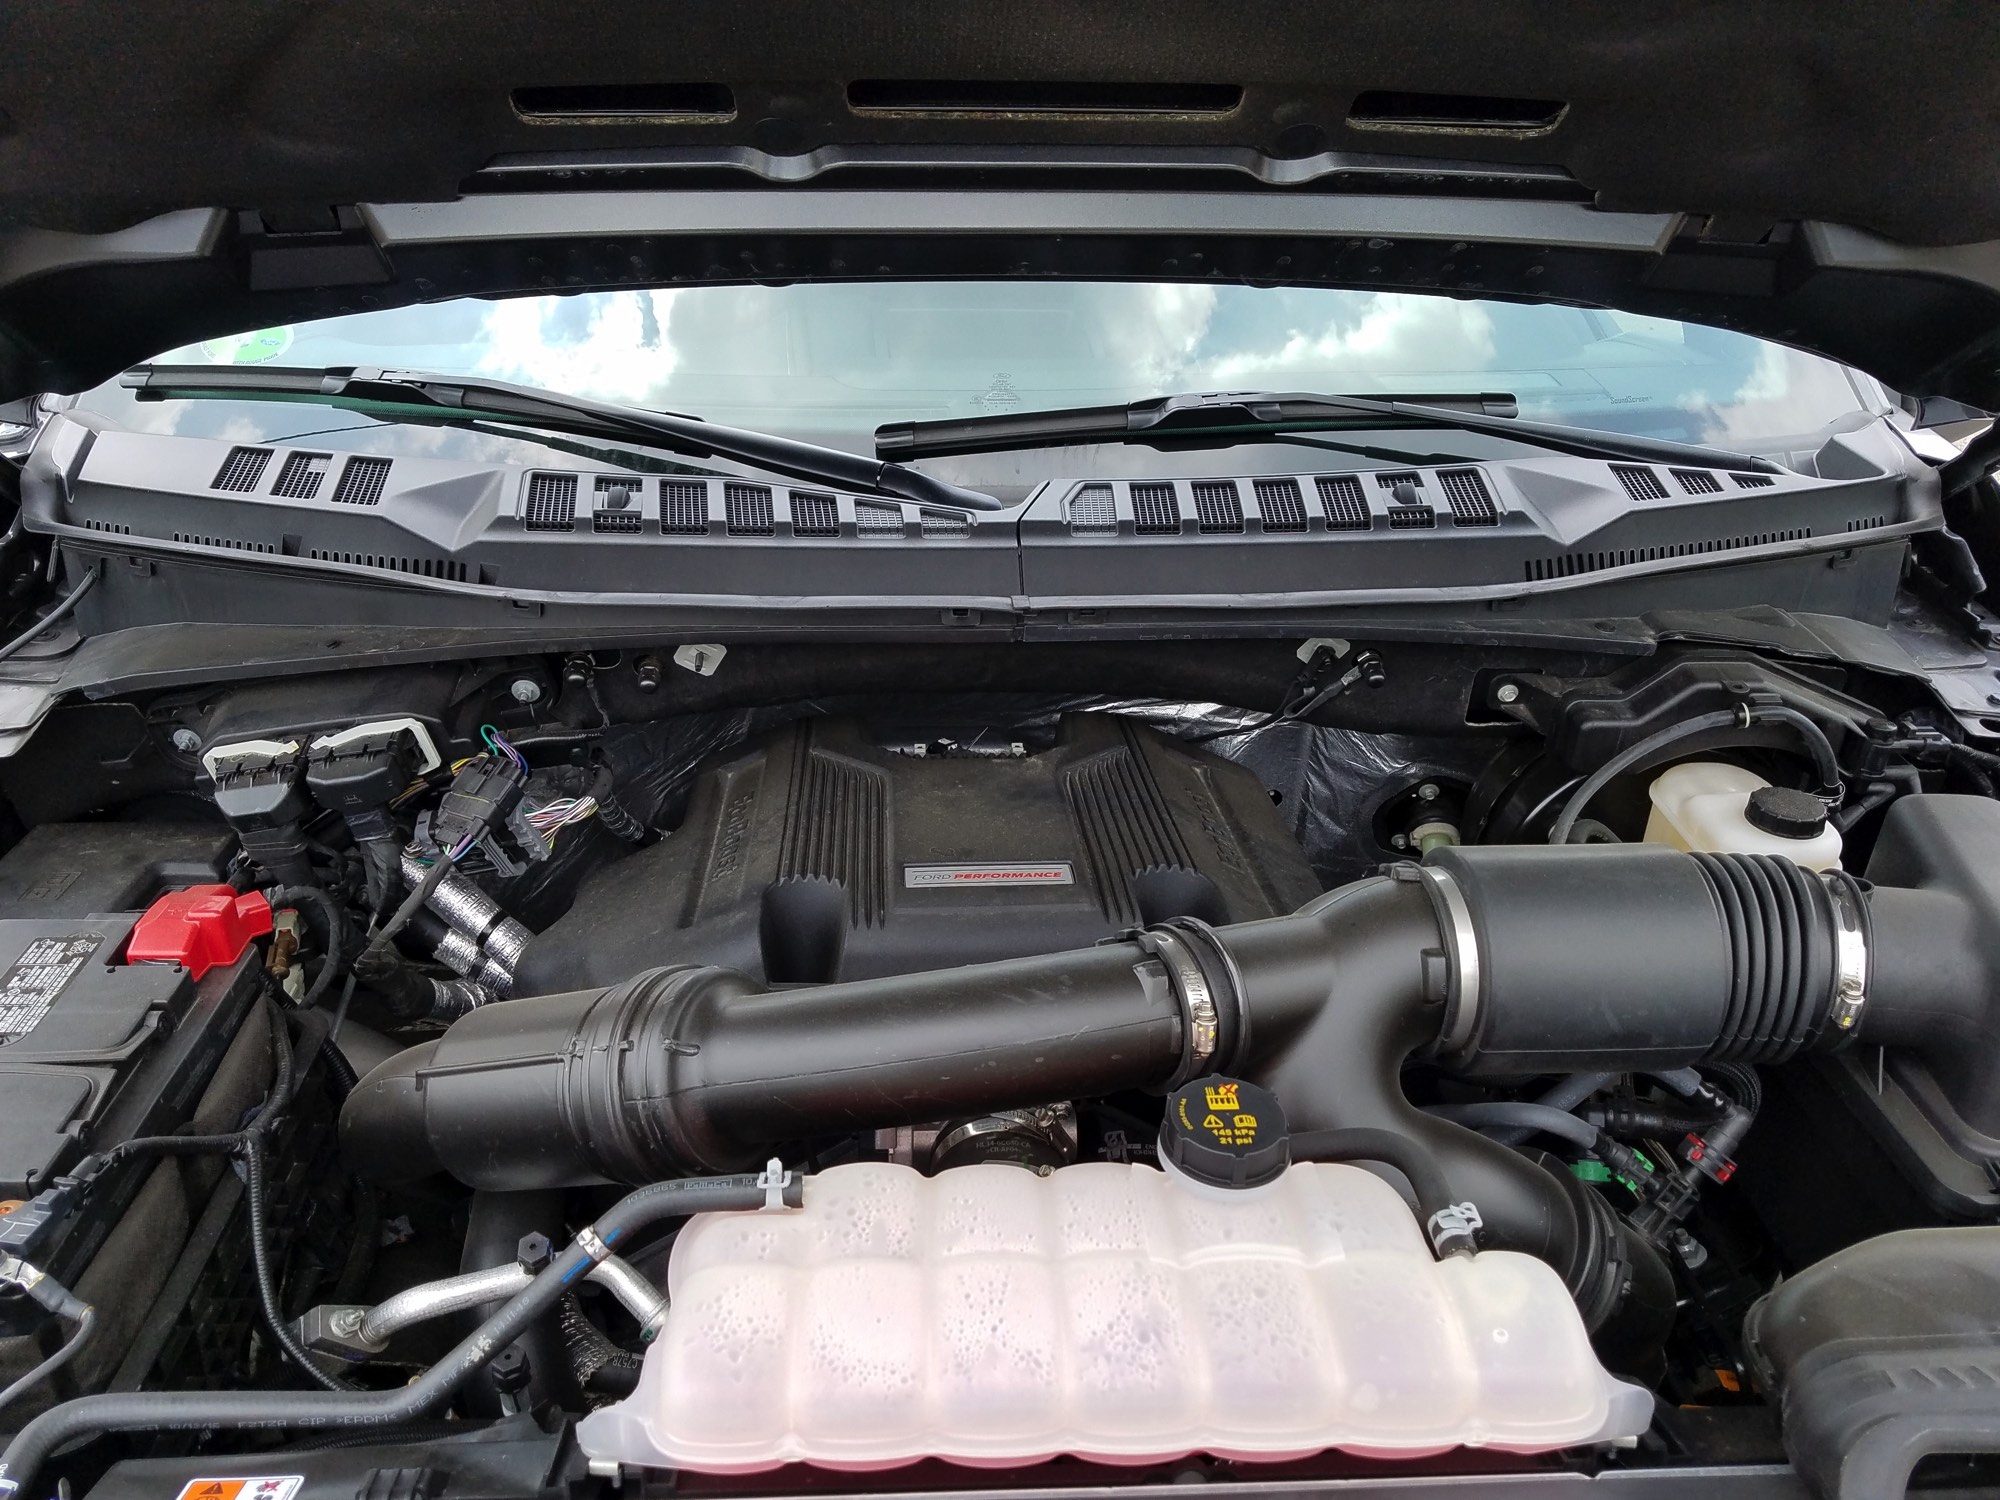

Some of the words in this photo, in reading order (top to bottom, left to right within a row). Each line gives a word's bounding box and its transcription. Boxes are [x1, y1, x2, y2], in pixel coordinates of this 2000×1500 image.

[913, 873, 952, 881] FORD
[953, 871, 1063, 880] PERFORMANCE
[1234, 1128, 1256, 1136] kPa
[1236, 1136, 1253, 1145] psi
[408, 1390, 439, 1415] MEX
